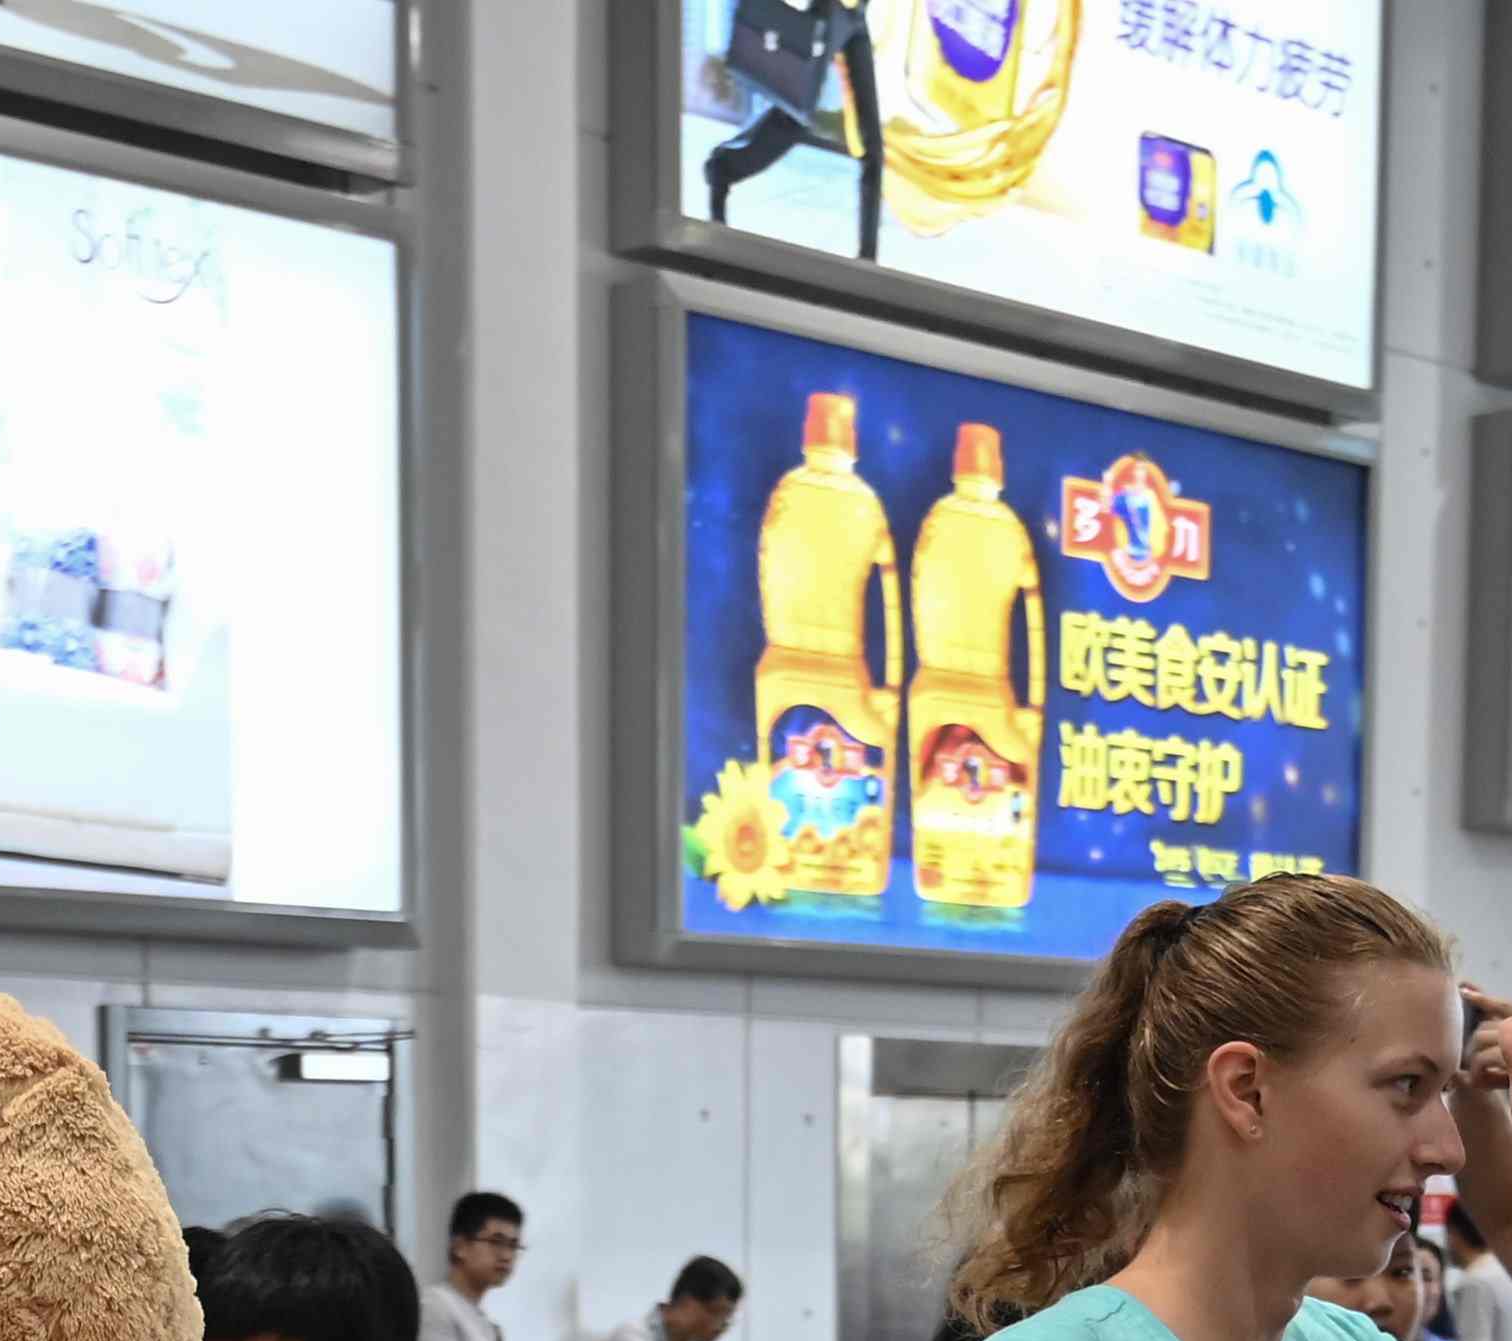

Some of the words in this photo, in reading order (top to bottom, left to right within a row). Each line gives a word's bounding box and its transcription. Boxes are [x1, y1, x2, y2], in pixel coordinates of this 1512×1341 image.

[1059, 610, 1329, 730] 欧美食安认证
[1058, 720, 1243, 824] 油衷守护
